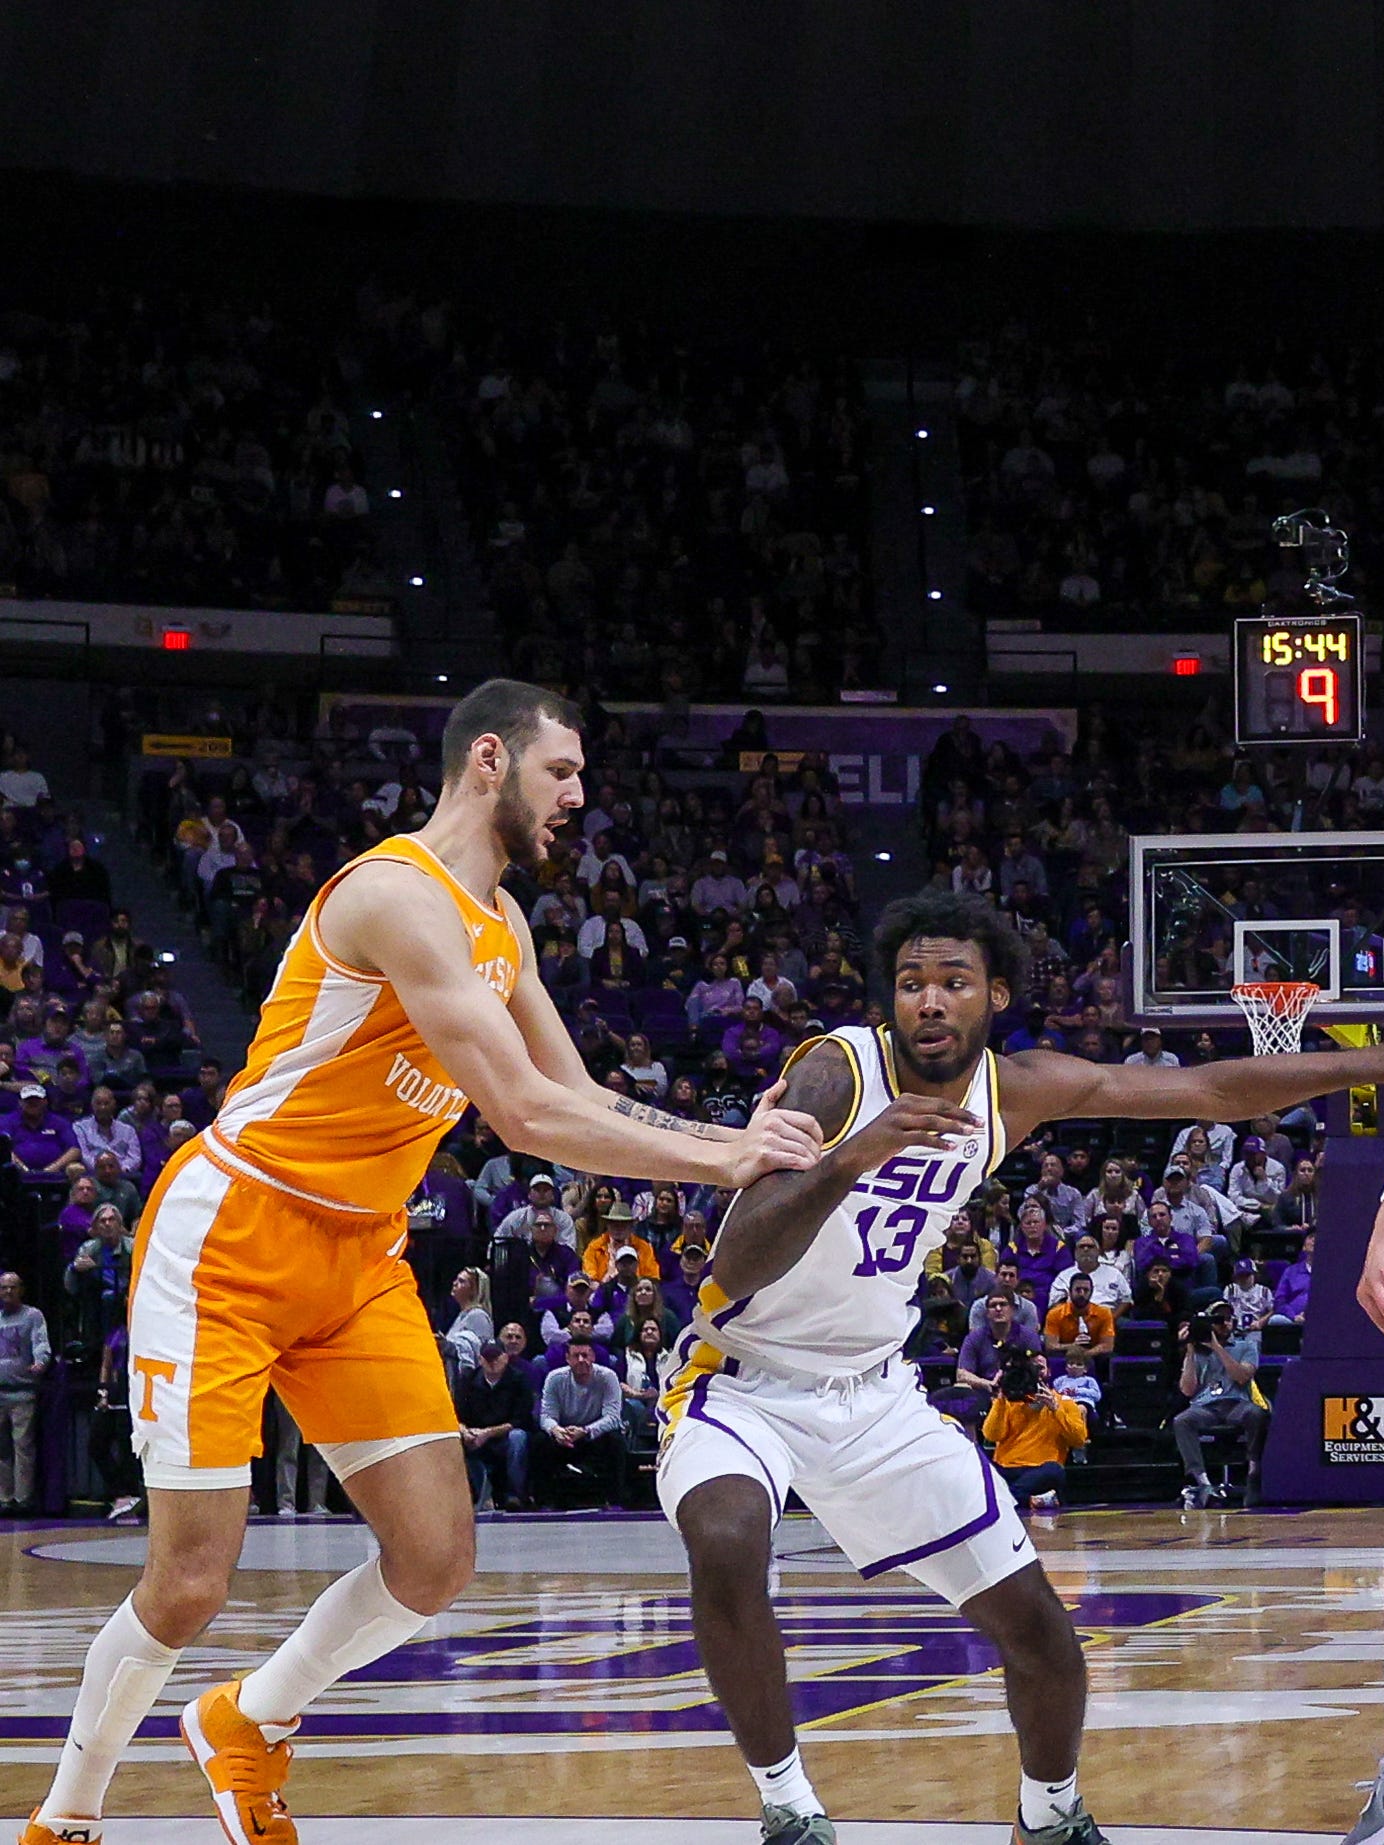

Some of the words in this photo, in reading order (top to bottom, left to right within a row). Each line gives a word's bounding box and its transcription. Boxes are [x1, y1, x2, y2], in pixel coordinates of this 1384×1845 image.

[1263, 631, 1347, 666] 15:44
[1299, 667, 1337, 725] 9
[851, 1204, 929, 1277] 13
[133, 1354, 178, 1423] T
